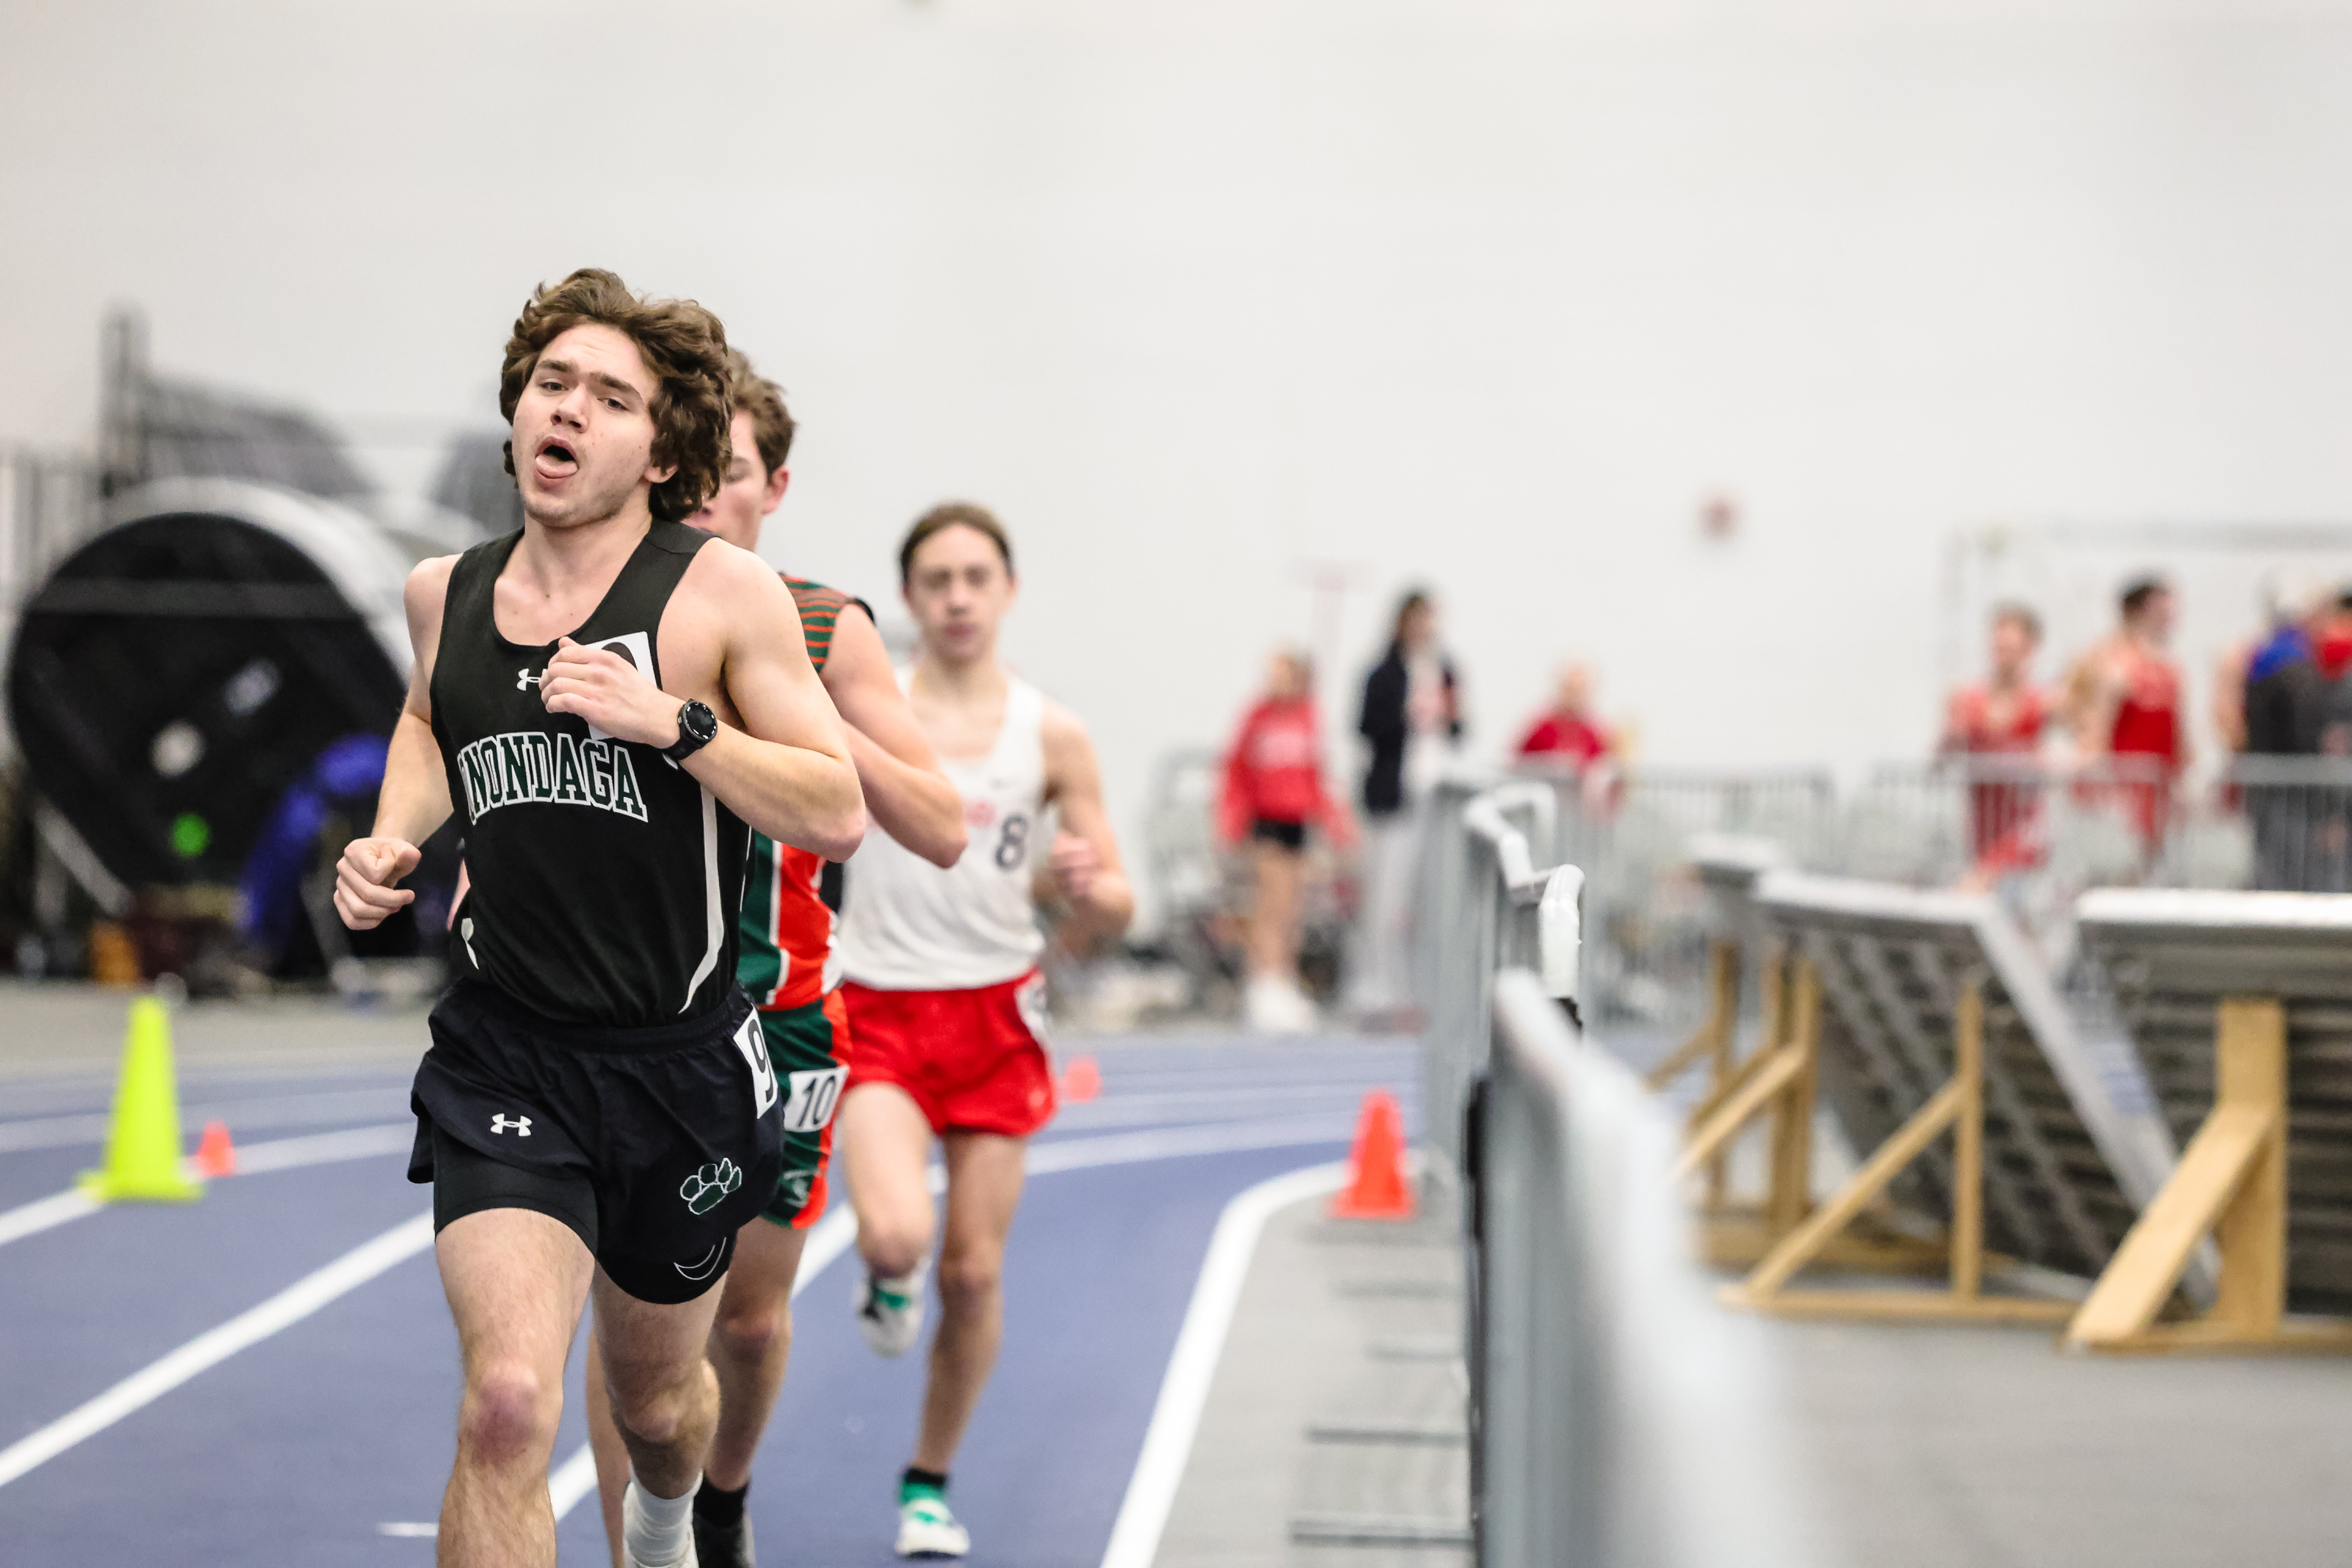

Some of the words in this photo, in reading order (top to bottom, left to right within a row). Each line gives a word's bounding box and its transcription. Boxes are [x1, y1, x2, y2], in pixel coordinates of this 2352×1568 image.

[457, 731, 648, 826] NONDAGA
[995, 811, 1029, 873] 8
[748, 1019, 774, 1103] 9
[799, 1075, 838, 1127] 10
